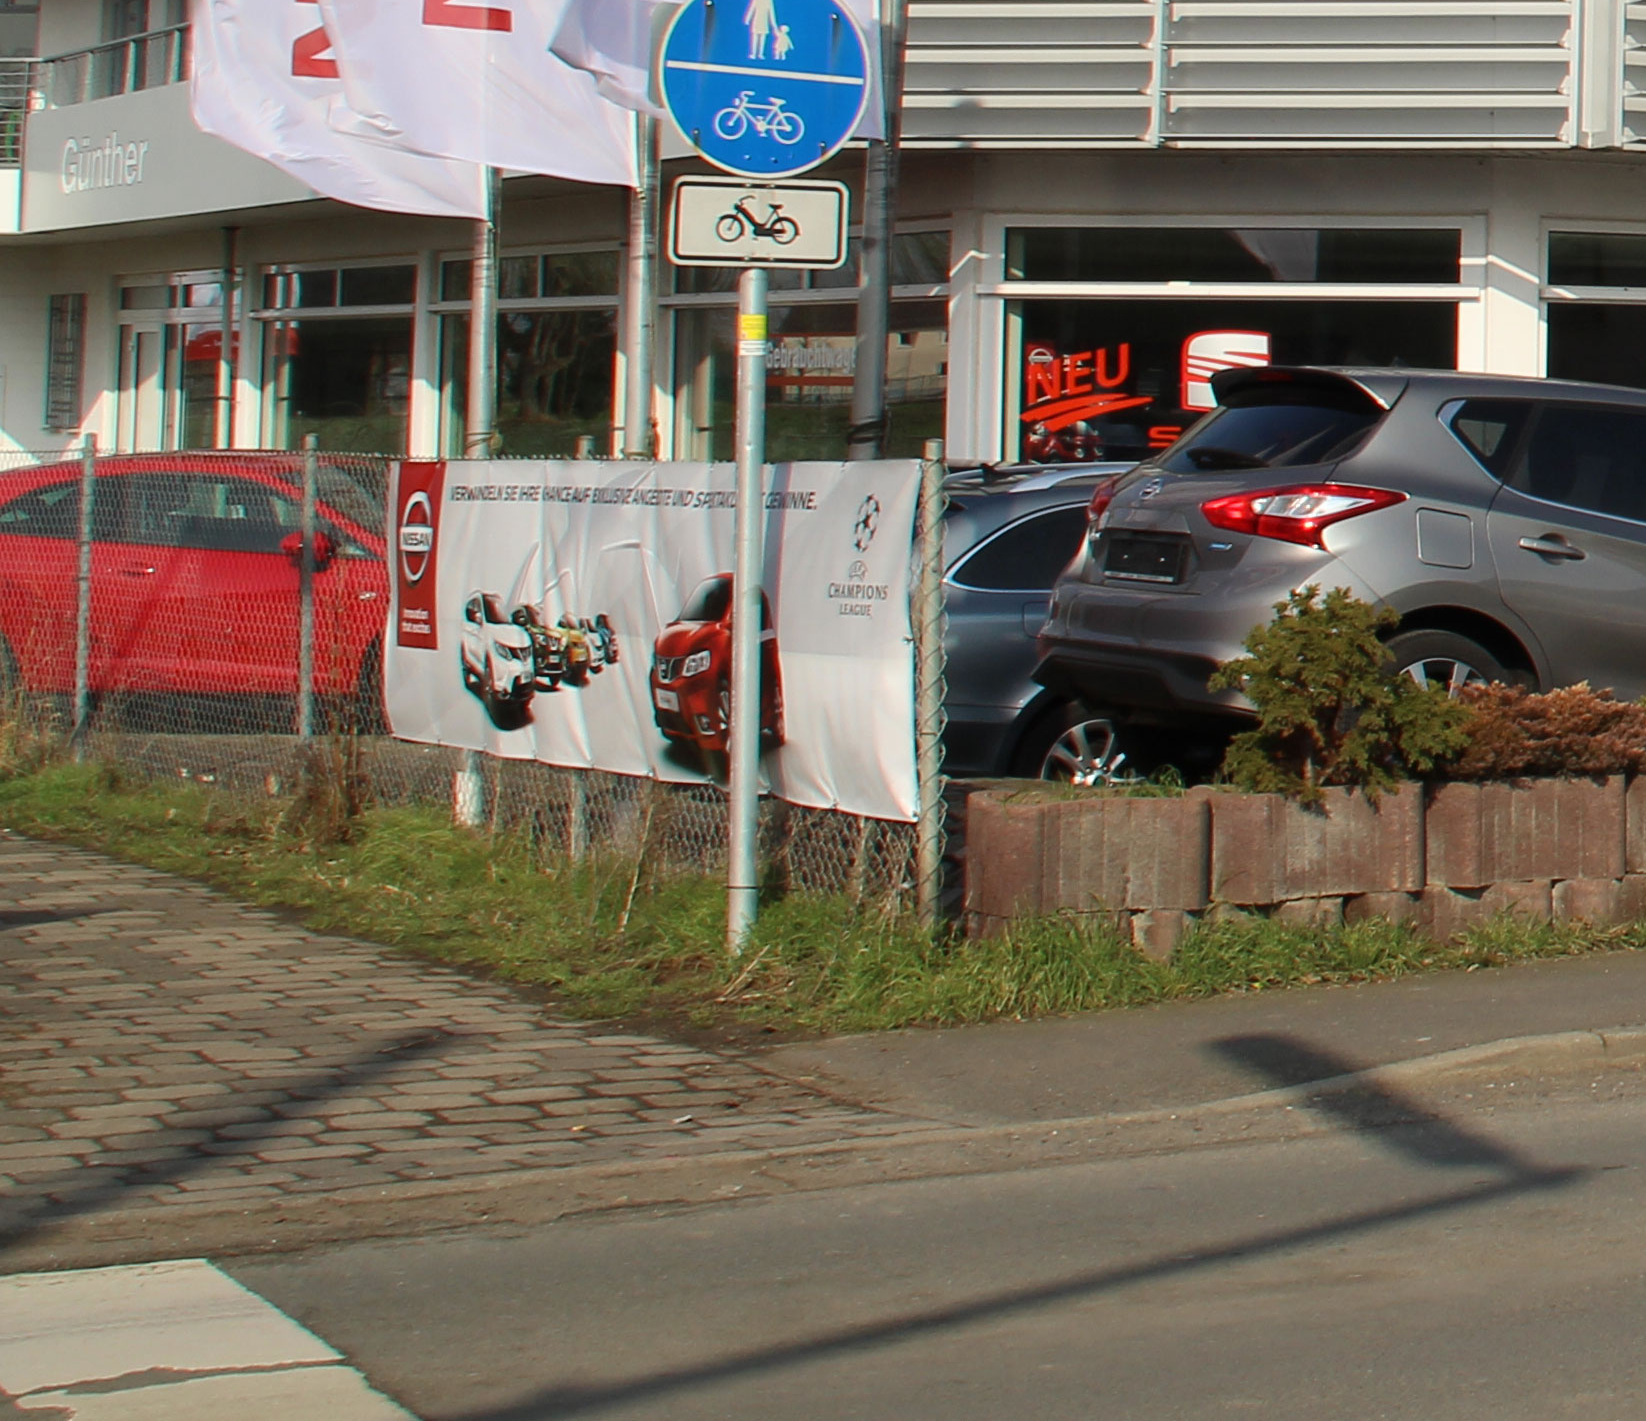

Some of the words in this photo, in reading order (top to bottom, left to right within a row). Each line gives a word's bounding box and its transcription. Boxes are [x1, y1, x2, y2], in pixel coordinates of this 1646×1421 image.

[61, 131, 148, 194] Günther
[1027, 343, 1130, 406] NEU
[828, 582, 889, 600] CHAMPIONS
[839, 603, 873, 616] LEAGUE
